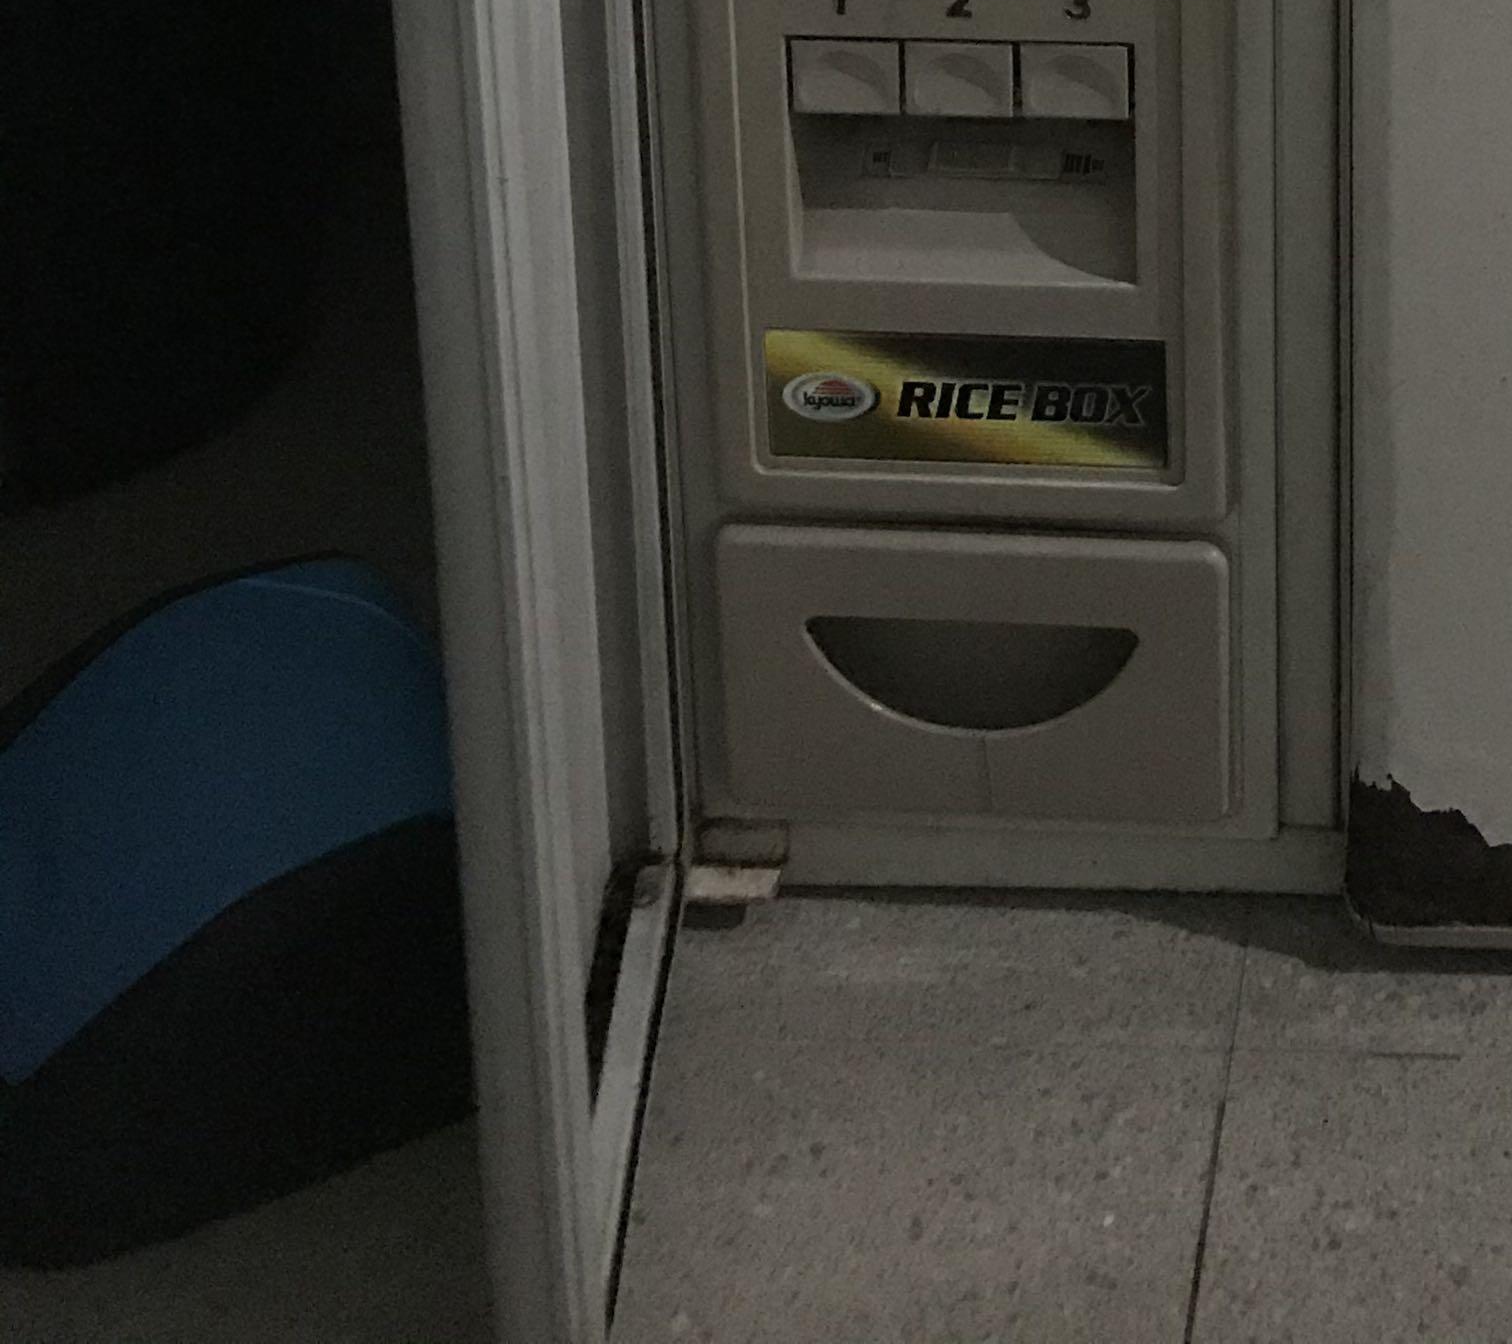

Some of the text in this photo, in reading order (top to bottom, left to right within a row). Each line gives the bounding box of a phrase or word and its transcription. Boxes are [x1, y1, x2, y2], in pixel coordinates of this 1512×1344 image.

[803, 391, 855, 410] kyowa
[896, 380, 1150, 426] RICE BOX
